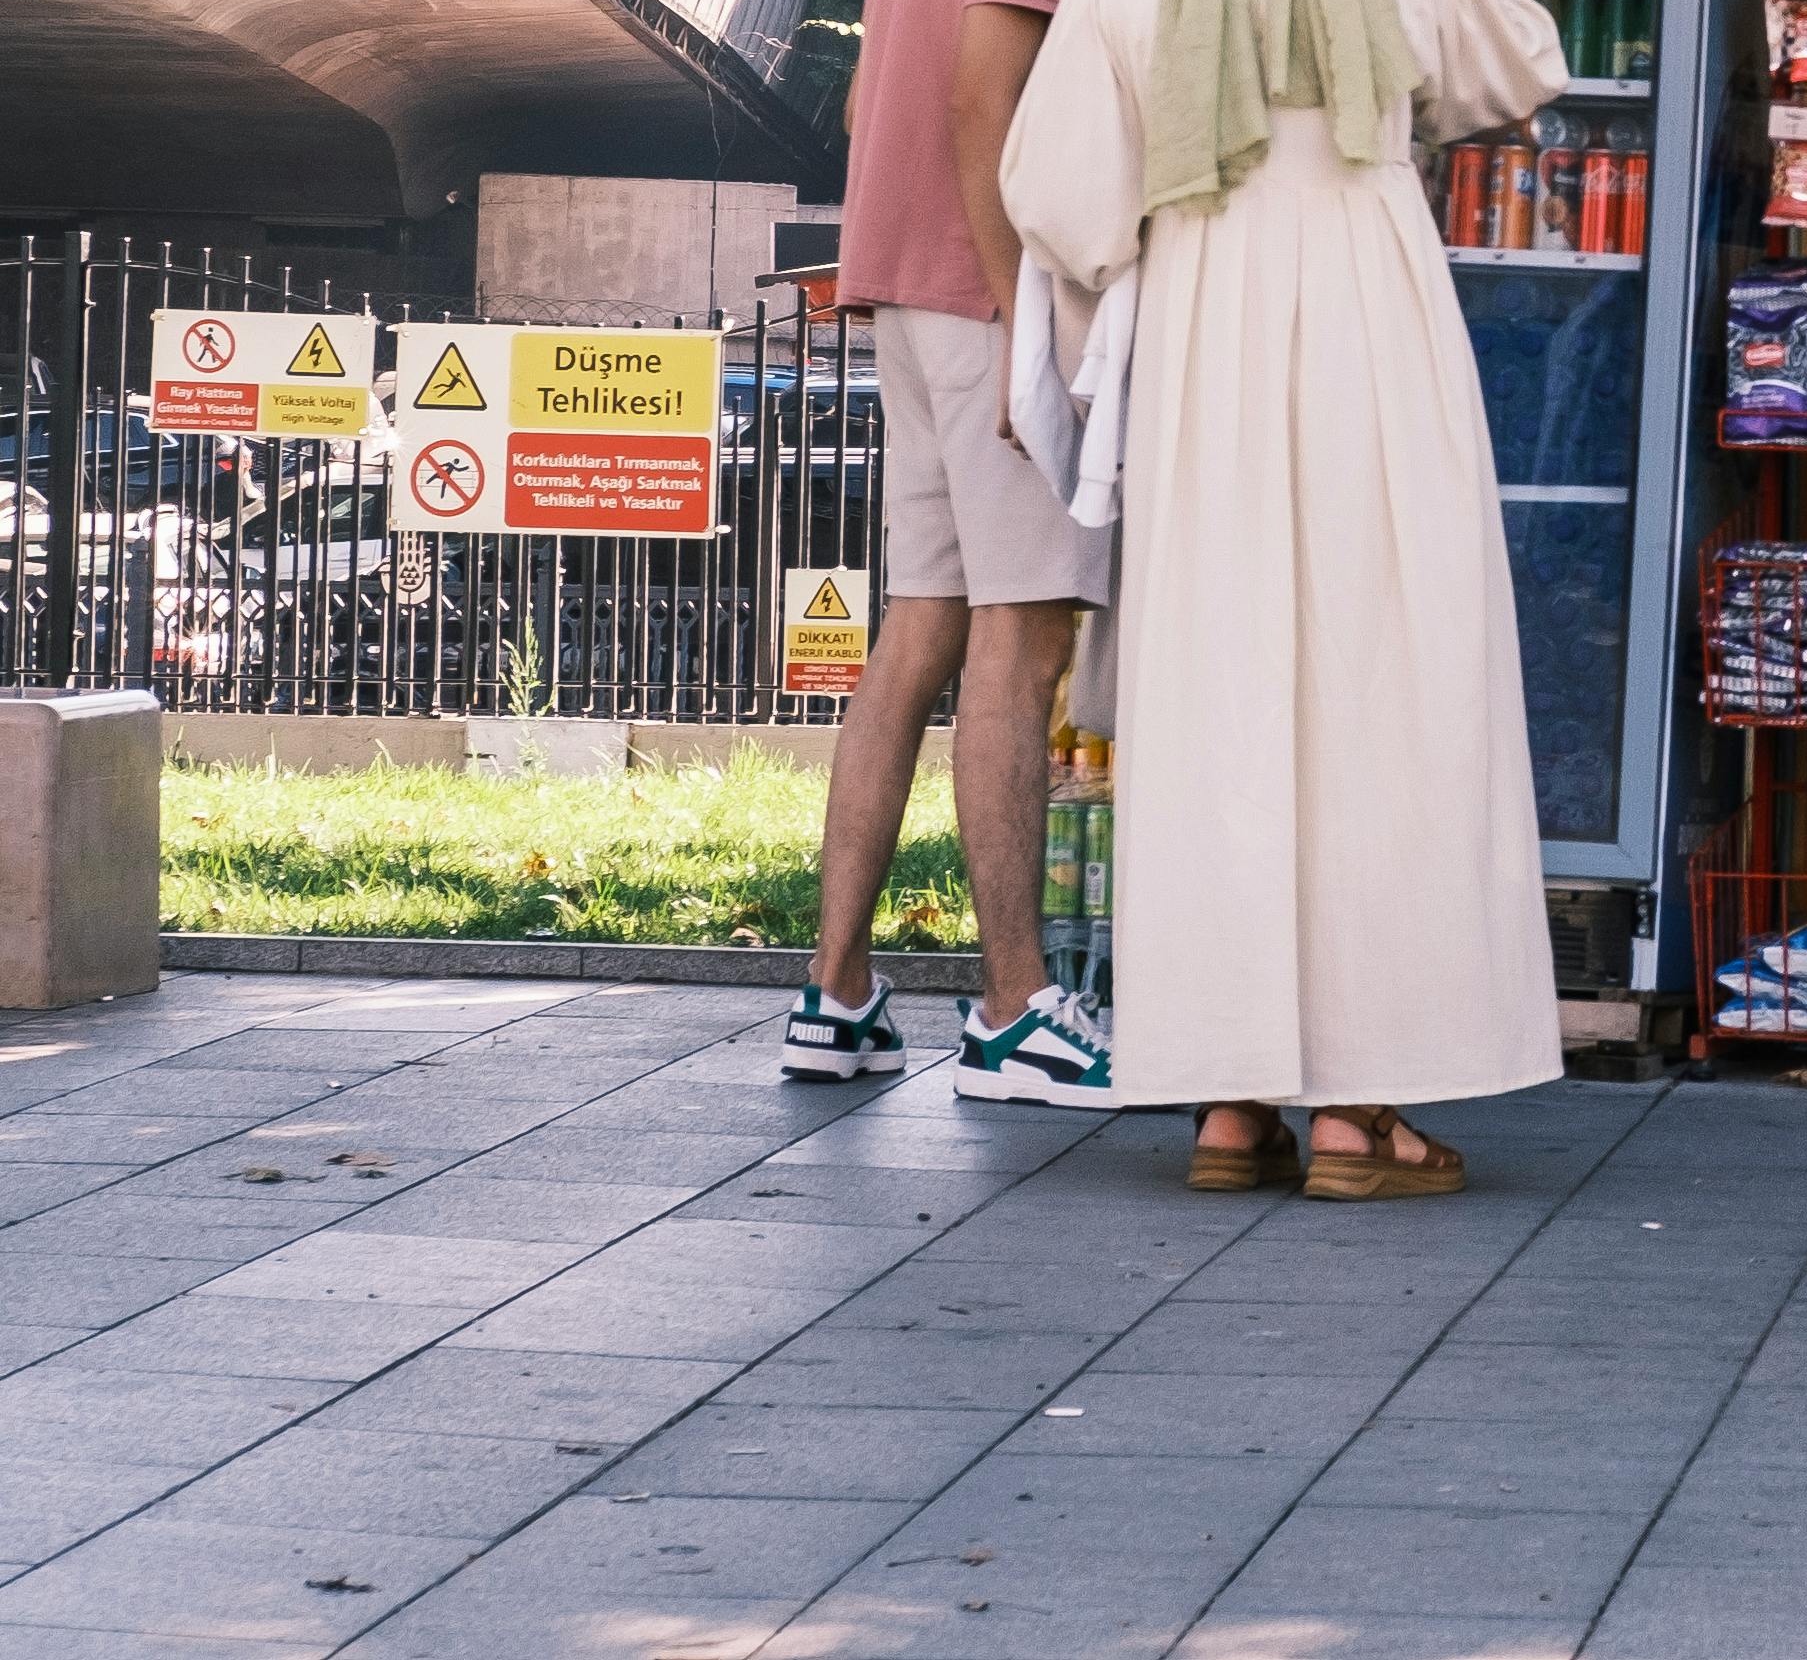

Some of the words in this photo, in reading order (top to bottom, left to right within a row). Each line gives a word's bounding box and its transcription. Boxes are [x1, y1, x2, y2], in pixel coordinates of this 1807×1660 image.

[555, 345, 662, 380] Düşme
[170, 386, 193, 400] Ray
[537, 386, 683, 416] Tehlikesi!
[157, 401, 202, 414] Girmek
[273, 394, 316, 407] Yüksek
[320, 397, 356, 412] Voltaj
[281, 413, 305, 425] High
[306, 414, 344, 426] Voltage
[512, 452, 611, 469] Korkuluklara
[614, 455, 705, 473] Tırmanmak,
[513, 473, 585, 489] Oturmak,
[589, 475, 633, 492] Aşağı
[636, 476, 702, 491] Sarkmak
[532, 492, 595, 508] Tehlikeli
[599, 497, 618, 508] ve
[621, 496, 684, 511] Yasaktır
[797, 629, 854, 645] DİKKAT!
[789, 647, 823, 658] ENERJİ
[825, 649, 862, 659] KABLO
